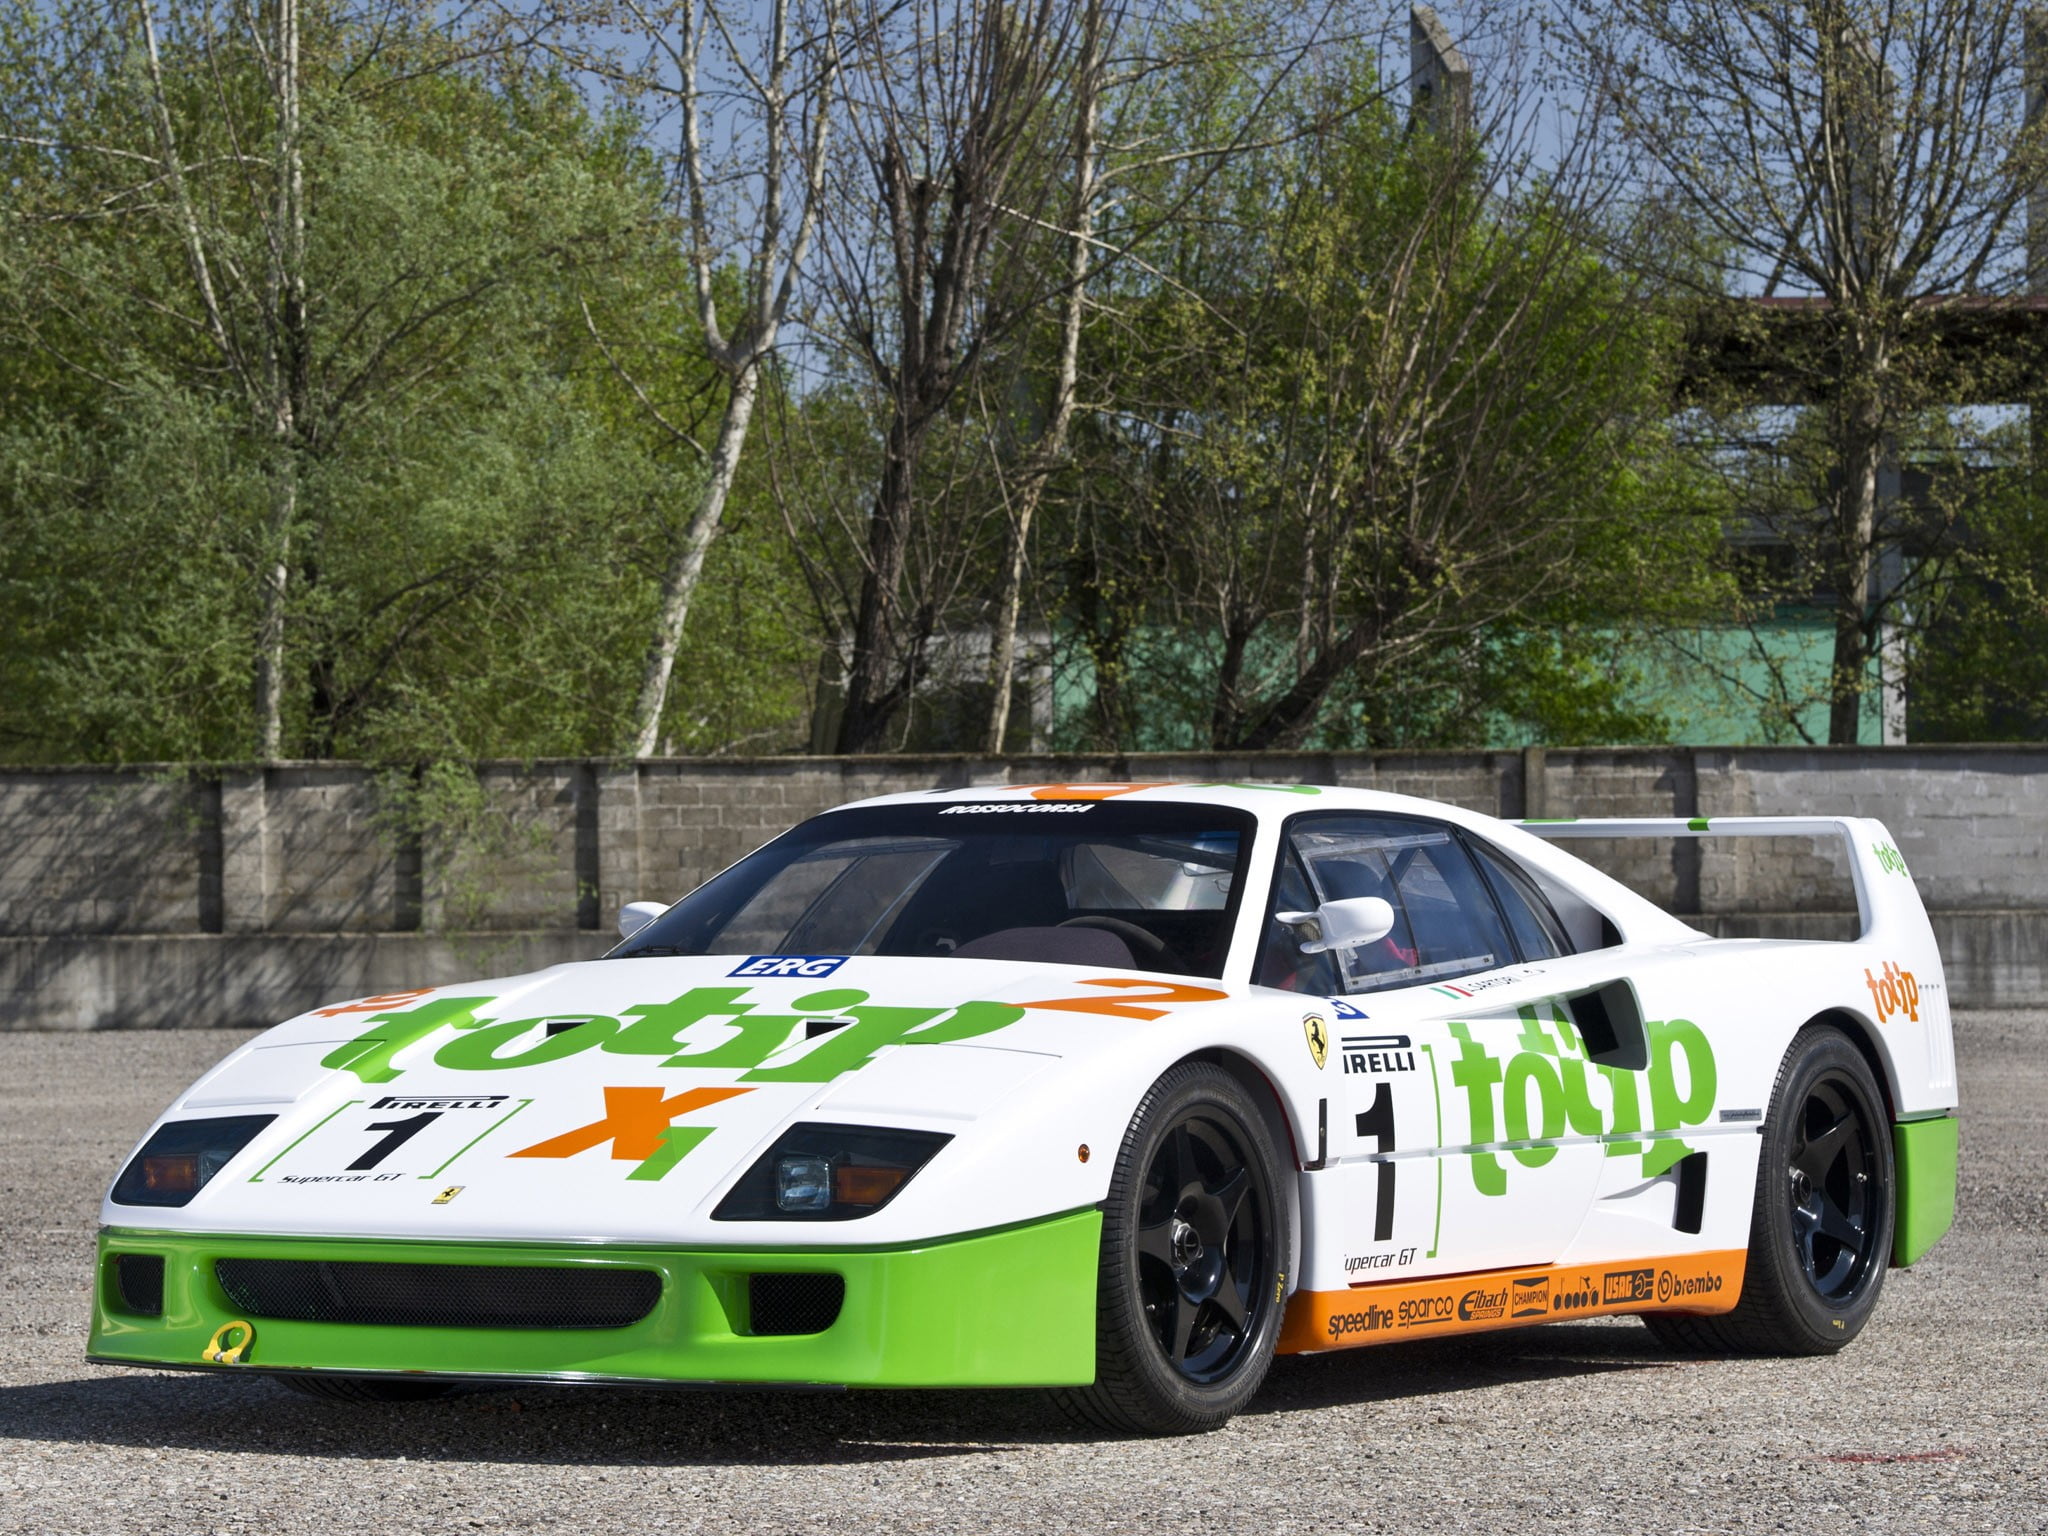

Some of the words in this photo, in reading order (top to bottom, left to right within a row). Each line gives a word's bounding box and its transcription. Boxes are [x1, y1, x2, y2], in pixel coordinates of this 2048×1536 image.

[938, 804, 1096, 815] ROSSOCORSA
[1871, 840, 1908, 878] totip
[735, 957, 842, 976] ERG
[1864, 960, 1920, 1025] totip
[319, 986, 1027, 1084] totip
[368, 1095, 510, 1110] PIRELLI
[1446, 1000, 1718, 1197] totip
[344, 1111, 446, 1171] 1
[277, 1173, 371, 1185] Supercar
[373, 1172, 407, 1182] GT
[1355, 1082, 1396, 1242] 1
[1343, 1252, 1396, 1276] upercar
[1398, 1247, 1418, 1266] GT
[1514, 1288, 1548, 1307] CHAMPION
[1604, 1273, 1633, 1300] USAG
[1673, 1270, 1723, 1298] brembo
[1398, 1295, 1454, 1329] sparco
[1457, 1287, 1509, 1322] Eibach
[1327, 1303, 1394, 1342] speedline
